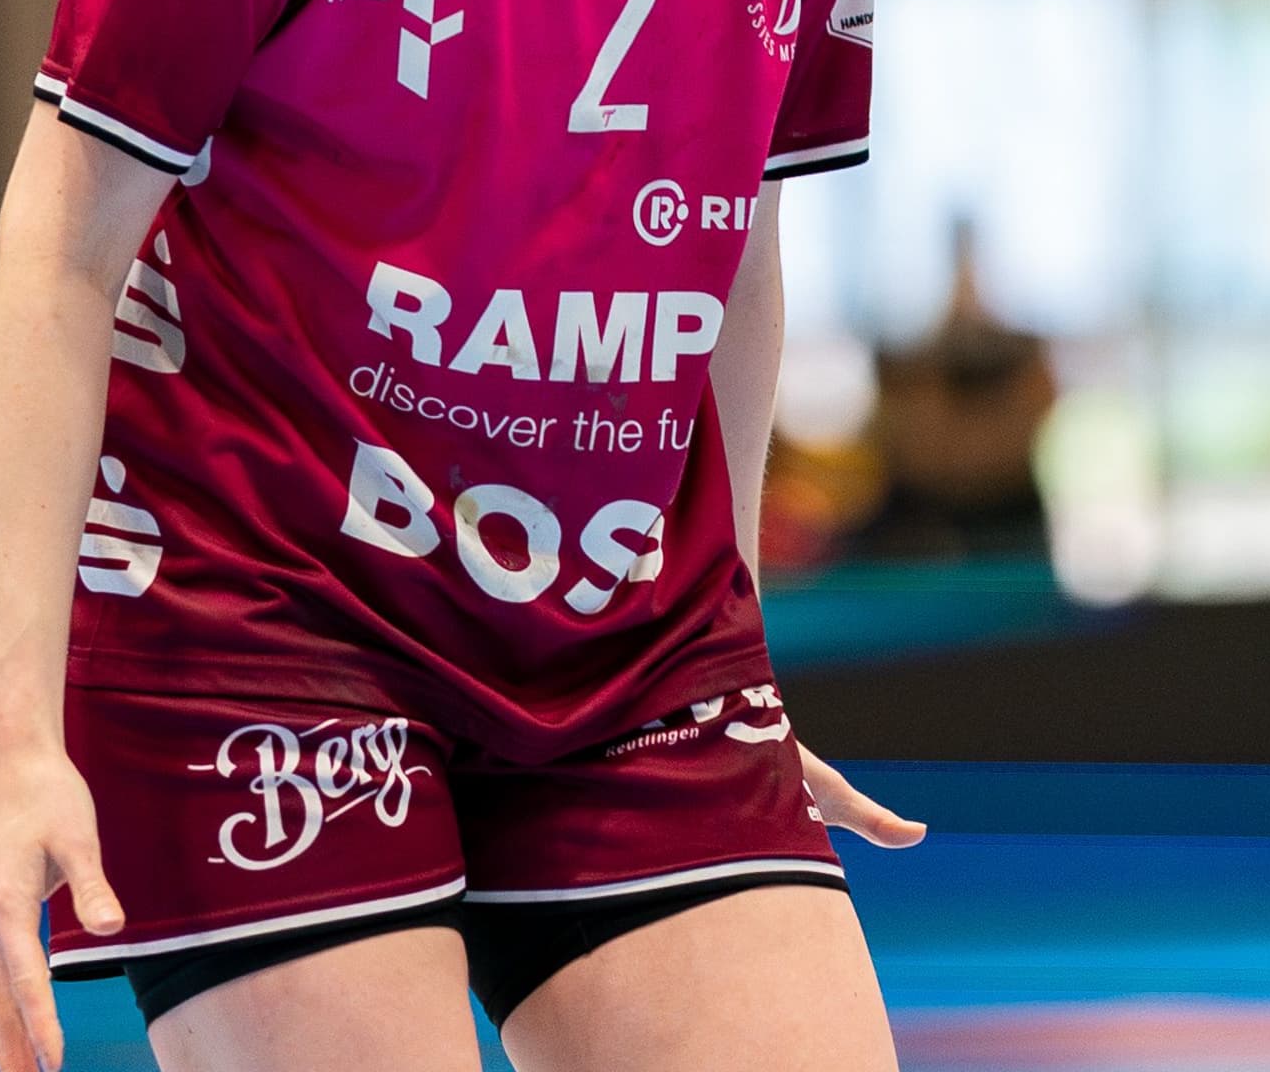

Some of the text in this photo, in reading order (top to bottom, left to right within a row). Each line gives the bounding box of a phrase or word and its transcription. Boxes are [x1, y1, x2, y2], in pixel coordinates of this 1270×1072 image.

[366, 260, 726, 383] RAMP
[348, 361, 557, 448] discover
[573, 409, 643, 452] the
[215, 717, 413, 871] Berg
[605, 727, 700, 758] Reutlingen
